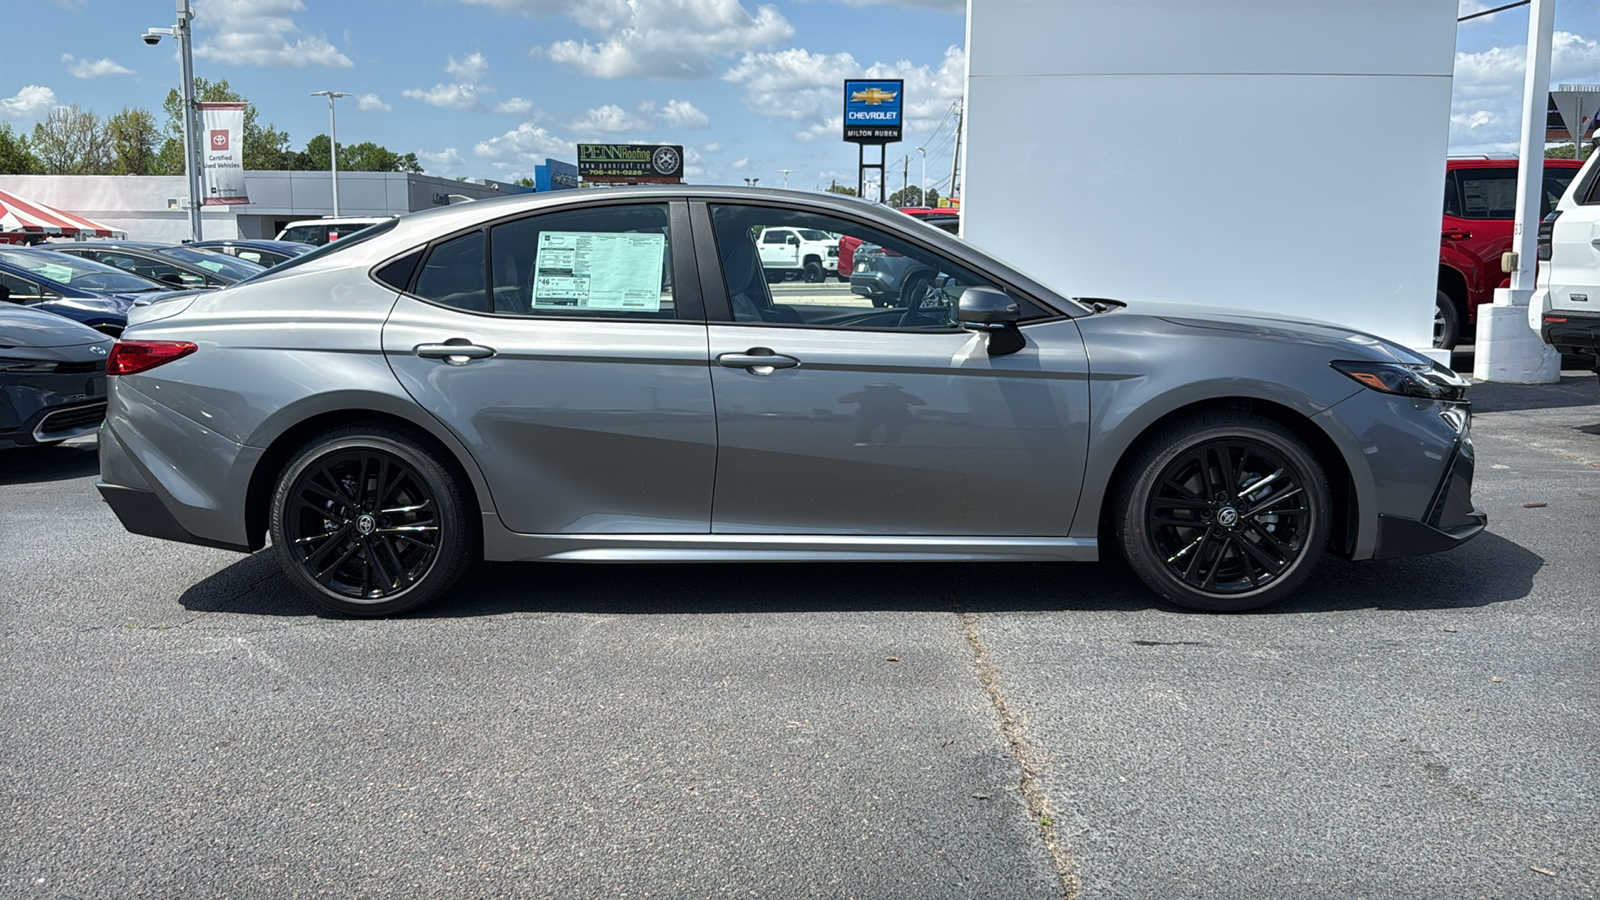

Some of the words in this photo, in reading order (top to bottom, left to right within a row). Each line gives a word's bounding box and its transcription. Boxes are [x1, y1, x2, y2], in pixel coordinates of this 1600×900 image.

[848, 111, 898, 120] CHEVROLET
[580, 145, 626, 159] PENN
[622, 147, 651, 162] Roofing
